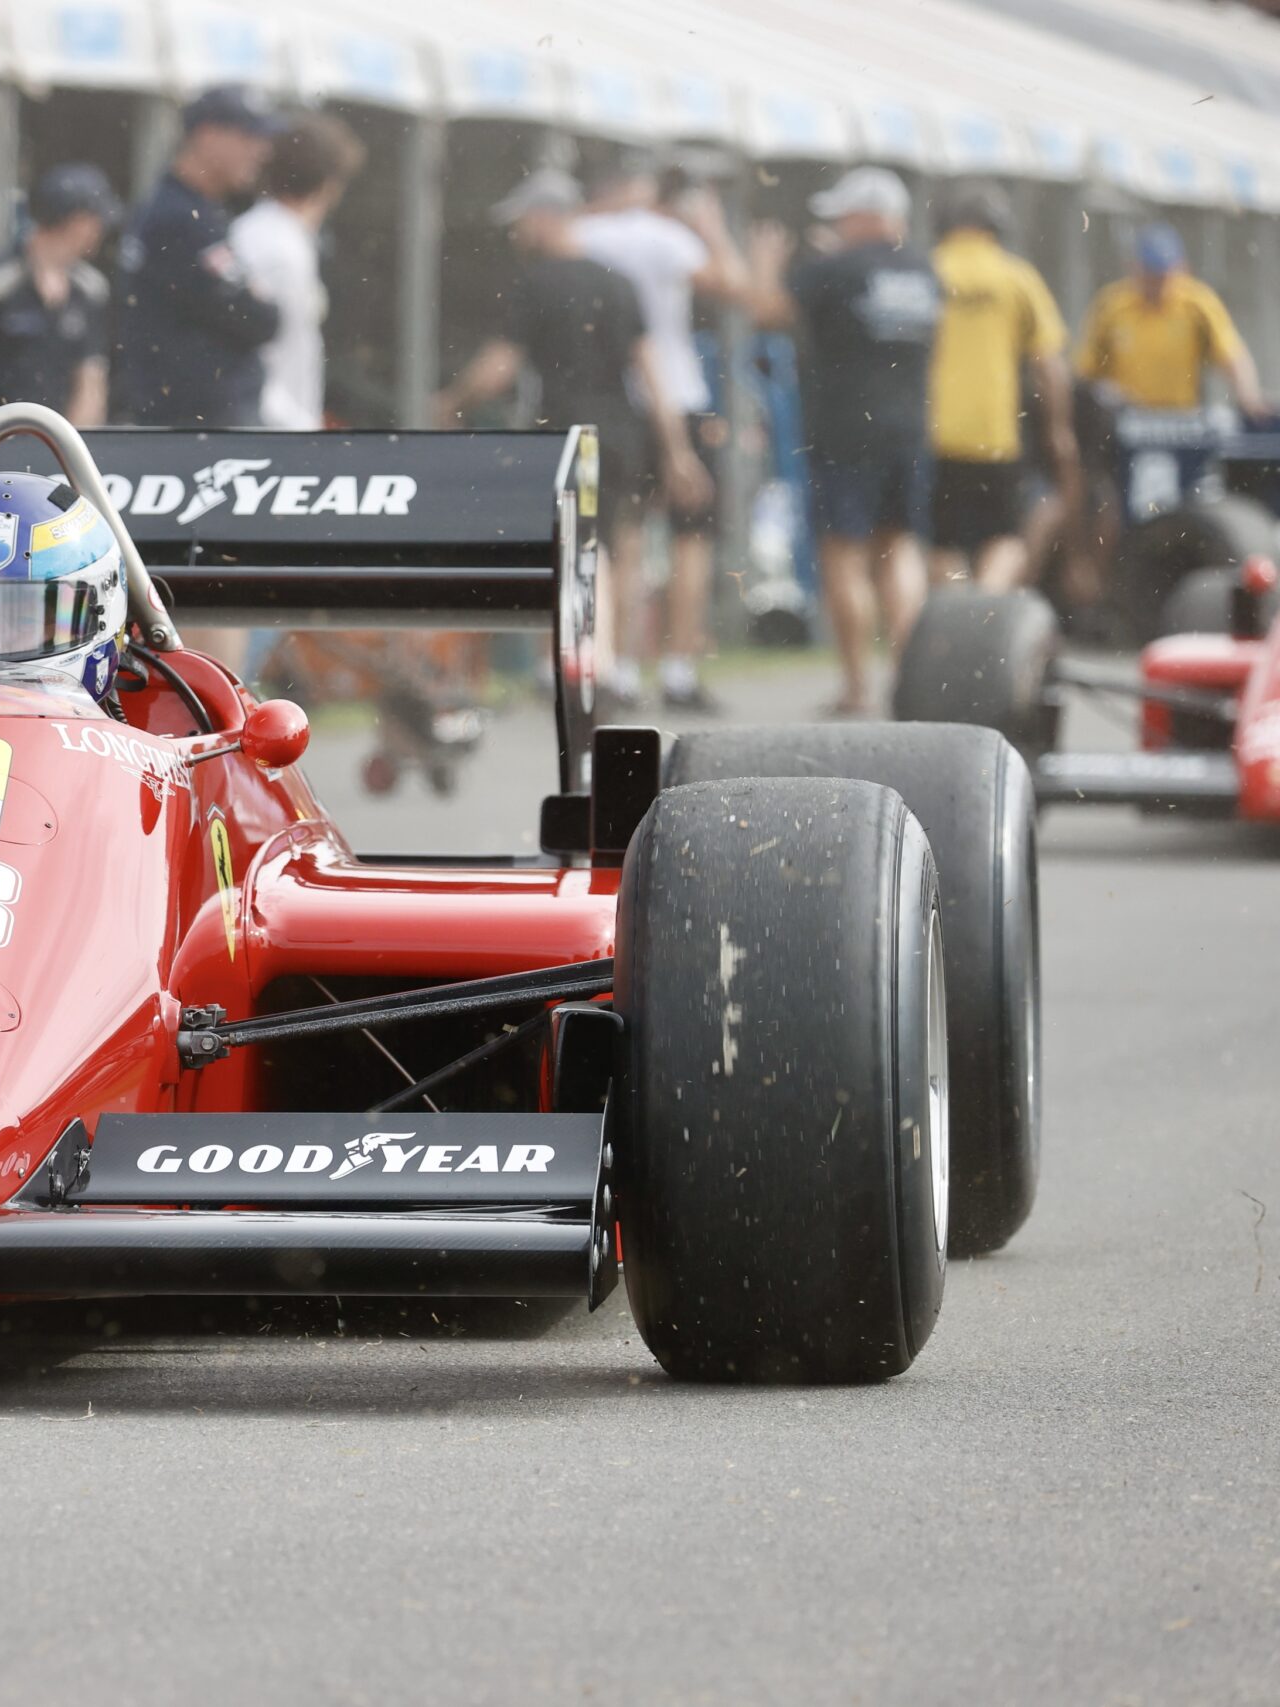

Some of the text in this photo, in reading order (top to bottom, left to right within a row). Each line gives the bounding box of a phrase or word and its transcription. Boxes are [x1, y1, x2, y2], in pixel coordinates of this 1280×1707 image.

[58, 474, 418, 515] OD YEAR
[51, 723, 192, 791] LONGINES
[136, 1144, 556, 1174] GOOD YEAR
